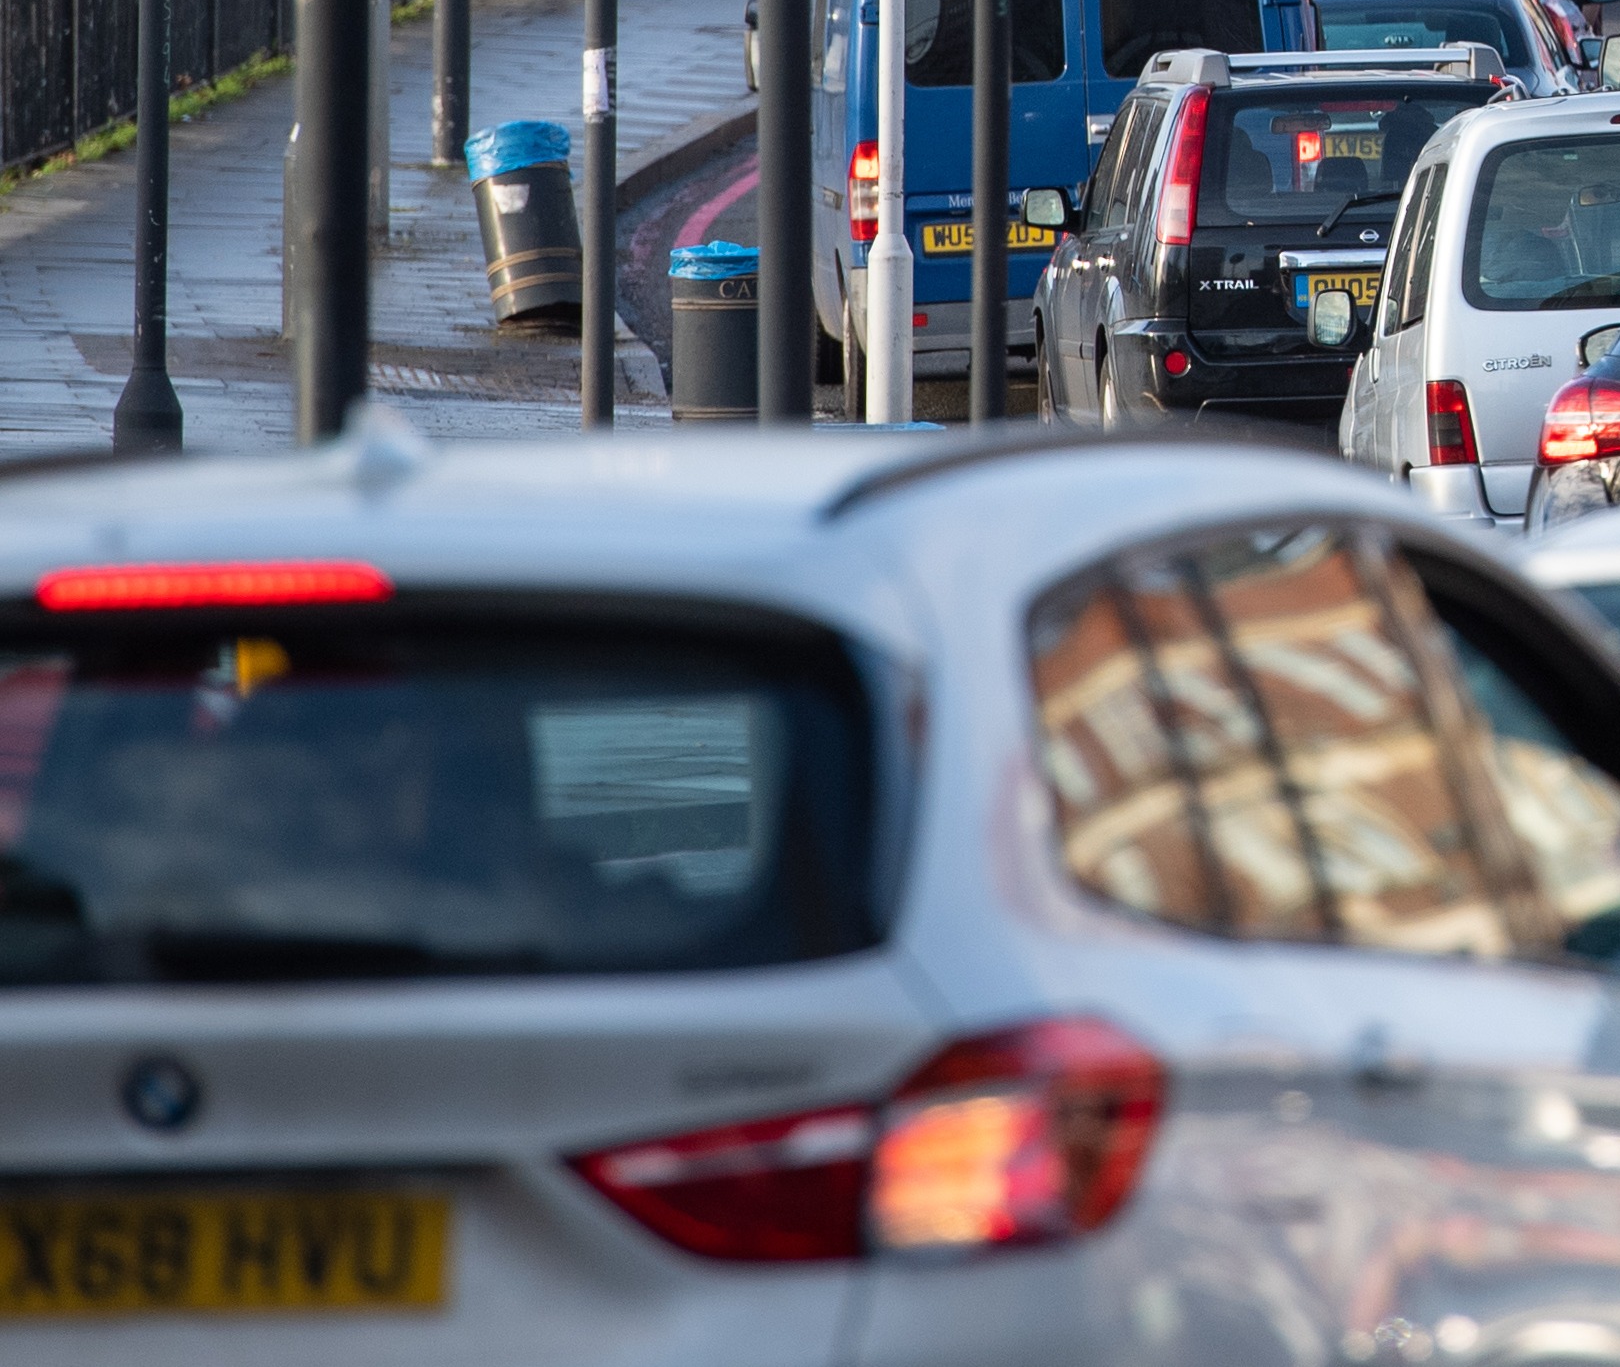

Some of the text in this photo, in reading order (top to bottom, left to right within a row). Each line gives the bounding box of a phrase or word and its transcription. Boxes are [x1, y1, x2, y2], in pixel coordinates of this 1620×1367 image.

[1199, 279, 1259, 290] X TRAIL
[1482, 354, 1551, 372] CITROËN
[220, 1202, 415, 1297] HVU
